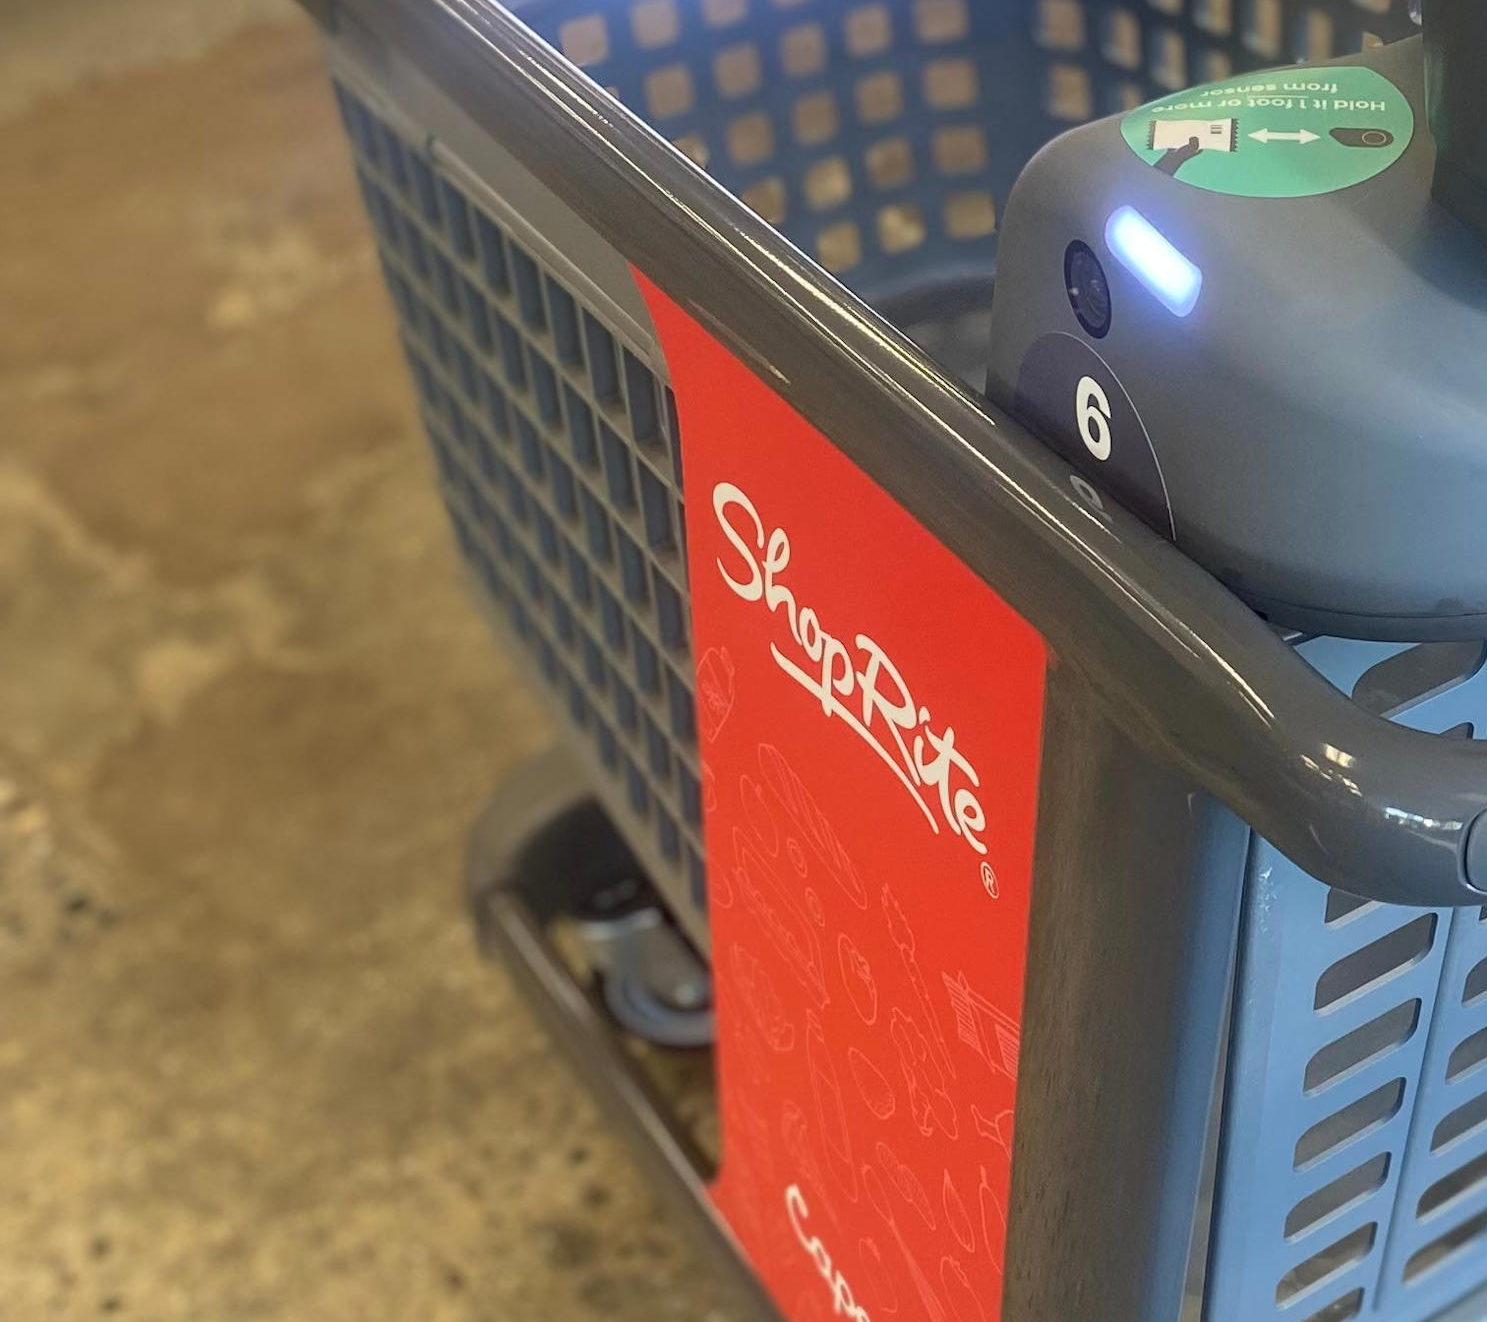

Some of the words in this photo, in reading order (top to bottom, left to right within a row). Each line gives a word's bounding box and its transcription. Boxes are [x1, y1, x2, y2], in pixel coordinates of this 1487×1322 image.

[1200, 82, 1278, 97] sensor
[1282, 82, 1339, 94] from
[1151, 100, 1212, 113] more
[1217, 98, 1242, 108] or
[1249, 97, 1293, 110] foot
[1312, 98, 1328, 111] it
[1333, 99, 1386, 111] Hold
[1075, 375, 1113, 462] 6
[712, 481, 988, 855] ShopRite
